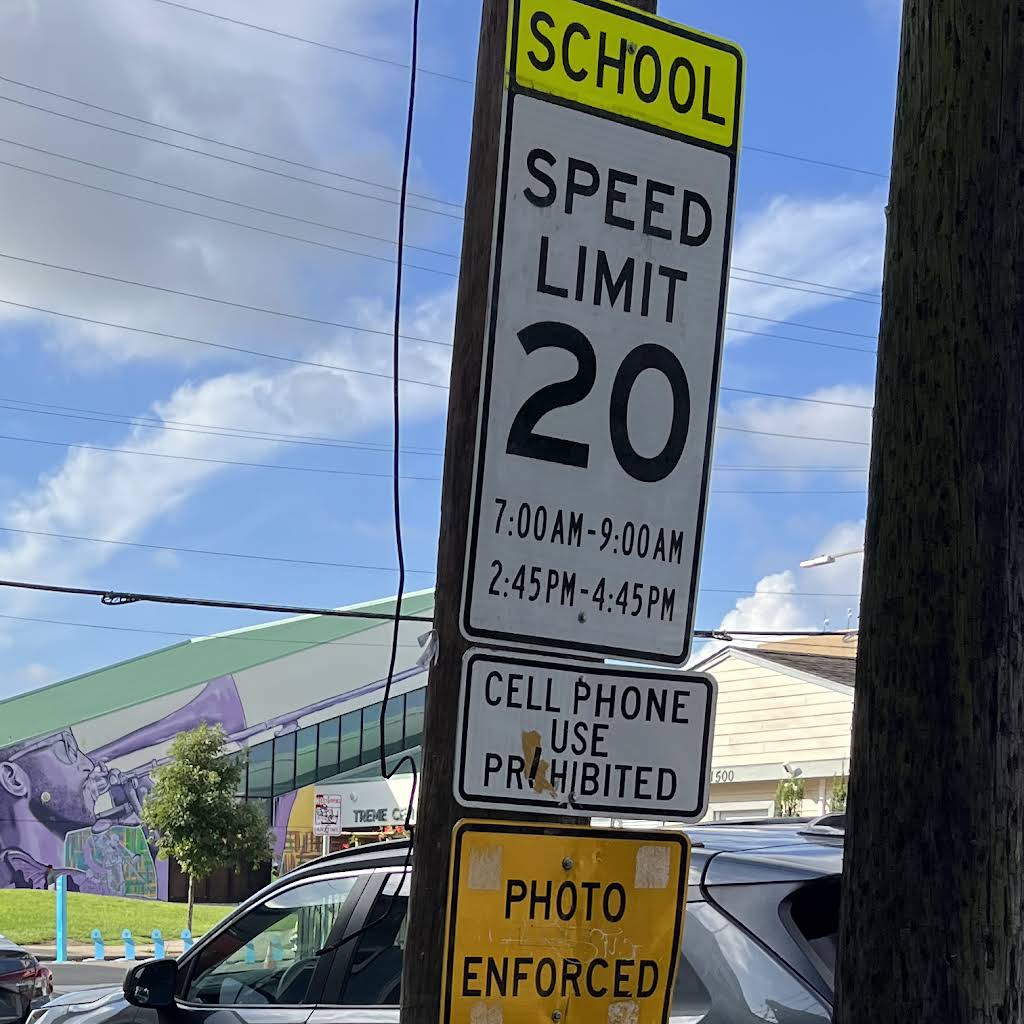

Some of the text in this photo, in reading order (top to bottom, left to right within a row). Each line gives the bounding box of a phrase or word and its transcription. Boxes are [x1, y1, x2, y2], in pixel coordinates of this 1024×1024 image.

[527, 11, 726, 126] SCHOOL
[523, 148, 713, 247] SPEED
[537, 236, 688, 323] LIMIT
[506, 321, 691, 483] 20
[494, 498, 684, 565] 7:00AM-9:00AM
[488, 560, 676, 622] 2:45PM-4:45PM
[484, 671, 691, 724] CELL PHONE
[551, 719, 609, 757] USE
[353, 808, 388, 823] TREME
[504, 879, 627, 923] PHOTO
[461, 956, 660, 999] ENFORCED
